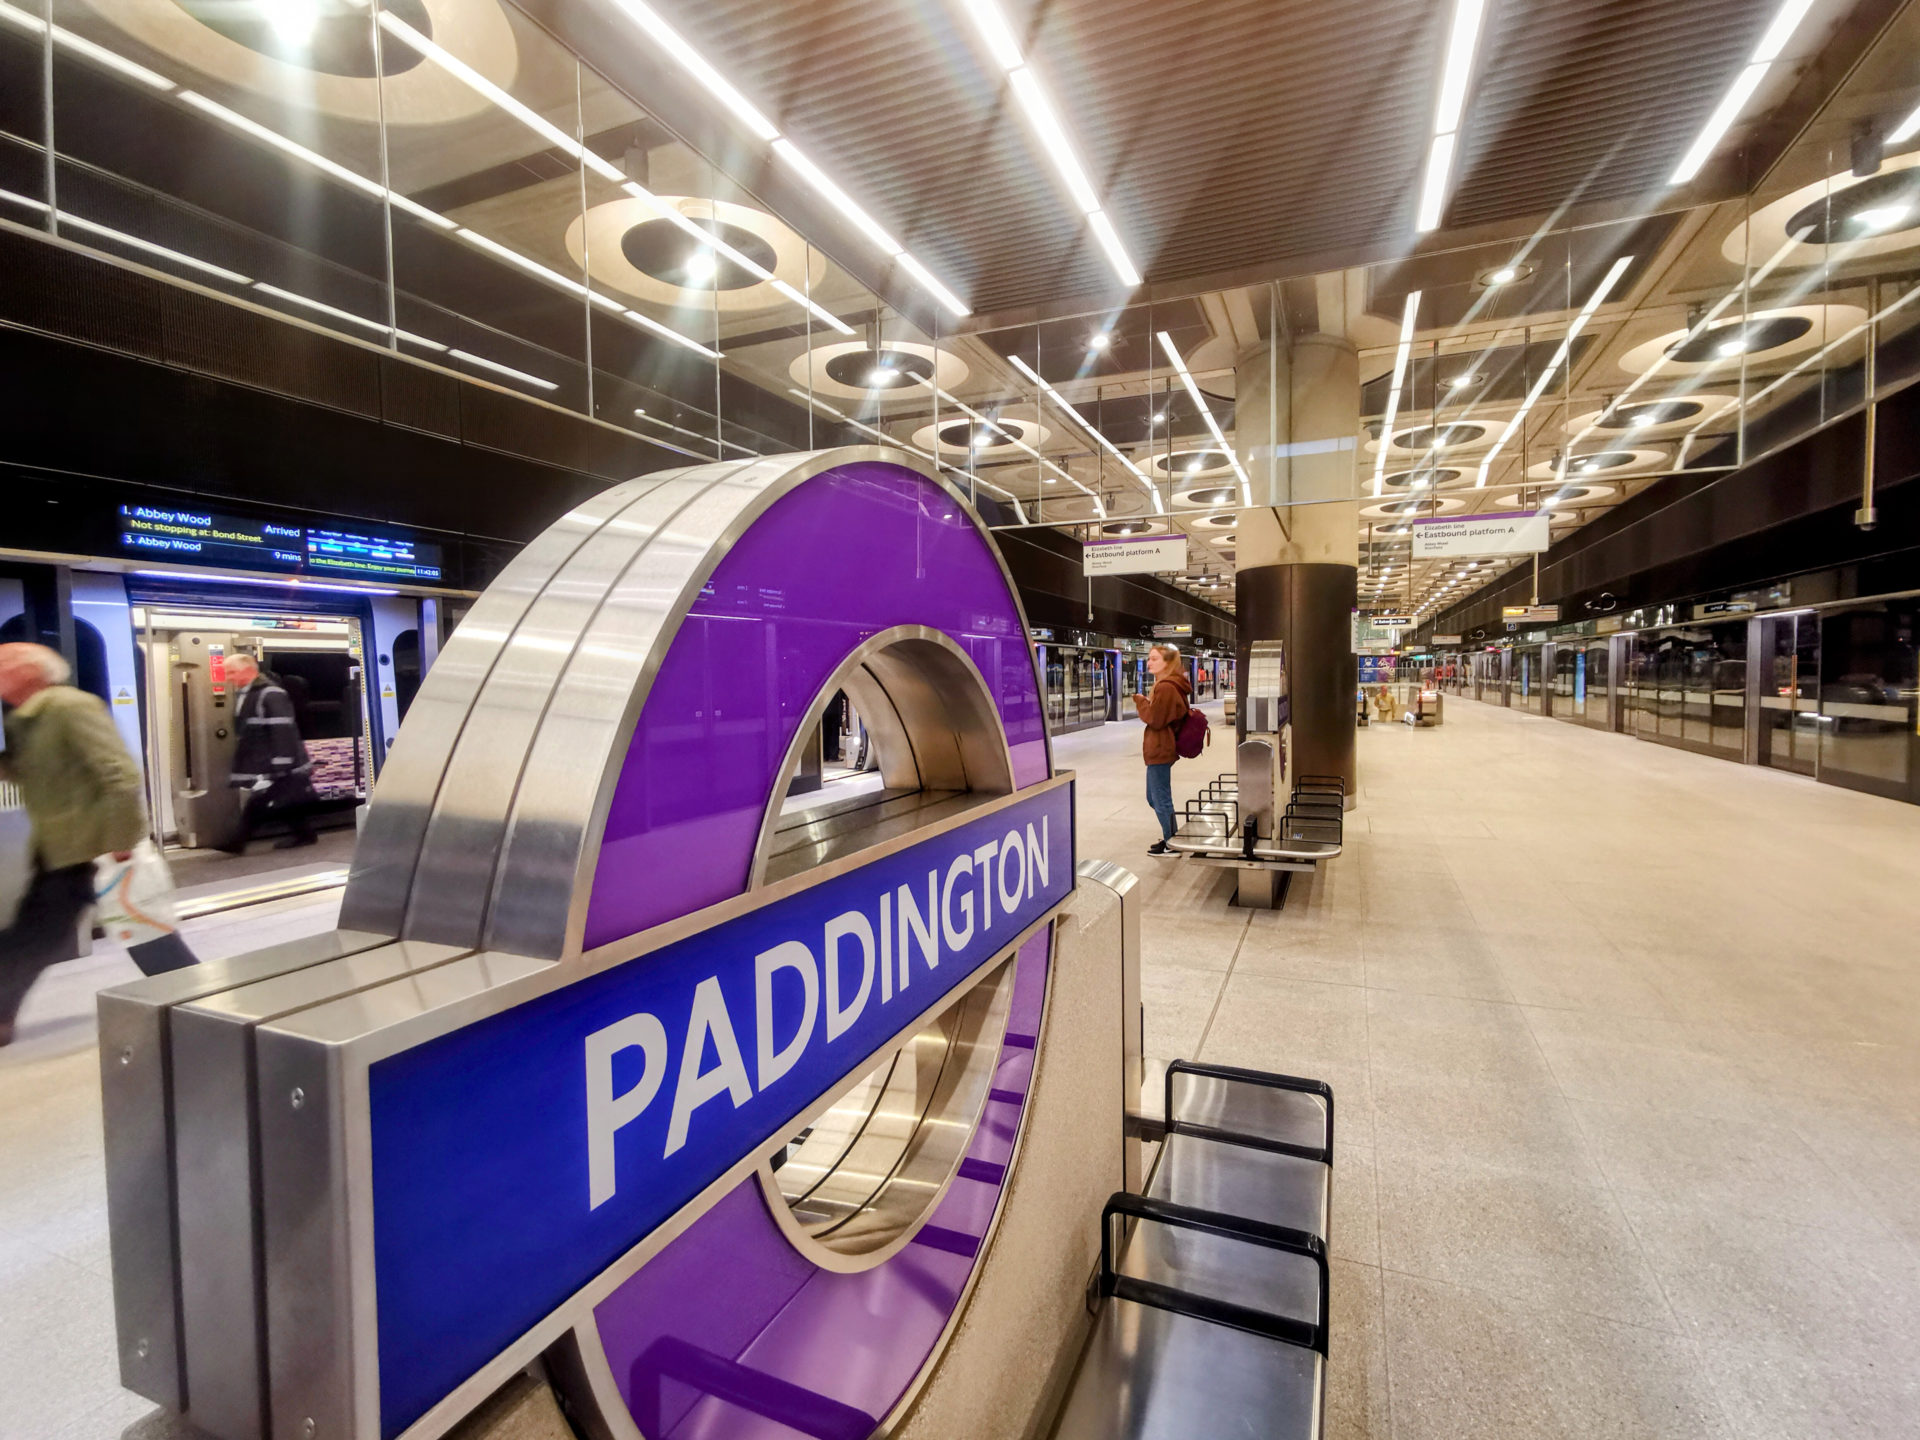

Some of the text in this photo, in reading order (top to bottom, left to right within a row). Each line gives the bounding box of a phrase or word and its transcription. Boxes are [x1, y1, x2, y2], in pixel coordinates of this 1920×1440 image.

[136, 507, 175, 523] Abbey
[178, 513, 212, 526] Wood
[131, 520, 153, 530] Not
[154, 524, 197, 536] stopping
[212, 530, 235, 540] Bond
[265, 525, 301, 537] Arrived
[1424, 530, 1467, 539] Eastbound
[1469, 527, 1506, 536] platform
[138, 536, 171, 549] Abbey
[172, 541, 202, 551] Wood
[274, 551, 302, 562] 9 mins
[1091, 550, 1125, 559] Eastbound
[1126, 548, 1154, 557] platform
[327, 559, 354, 568] Elizabeth
[585, 815, 1048, 1212] PADDINGTON
